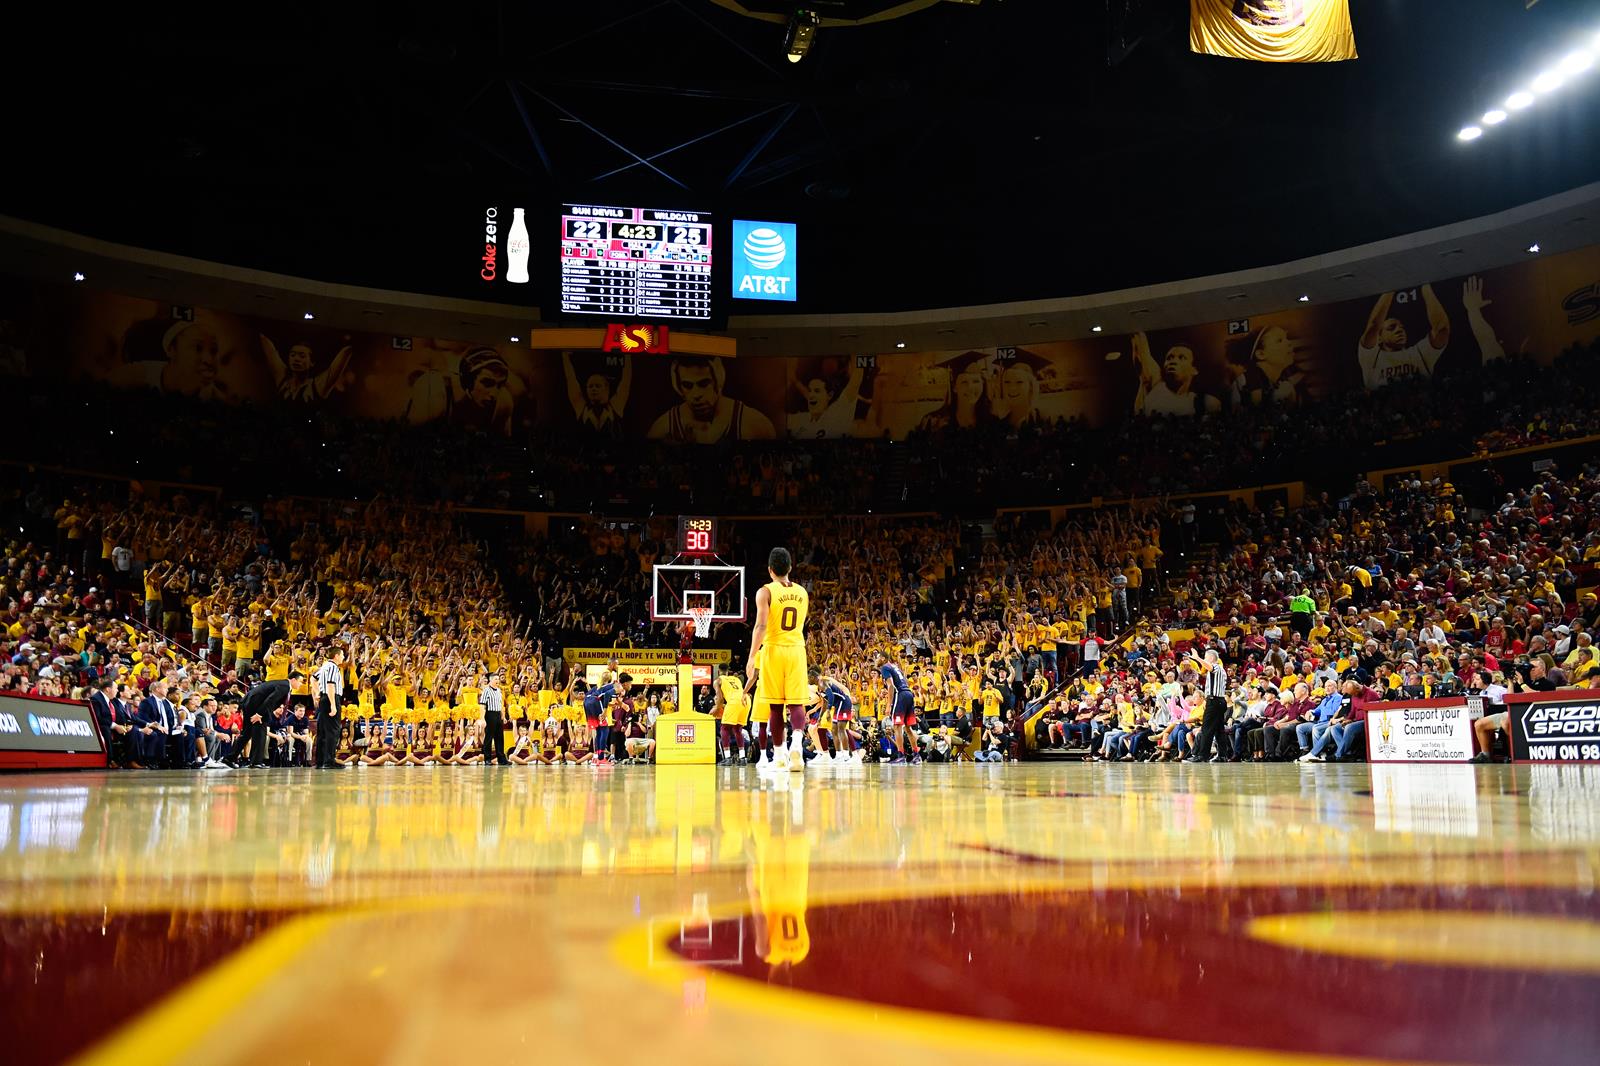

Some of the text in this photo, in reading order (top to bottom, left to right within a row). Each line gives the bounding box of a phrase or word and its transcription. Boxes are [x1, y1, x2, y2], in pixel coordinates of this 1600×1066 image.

[572, 207, 624, 217] SUN DEVILS
[654, 212, 699, 222] WILDCATS
[573, 221, 601, 238] 22
[618, 225, 656, 239] 4:23
[674, 227, 701, 245] 25
[480, 207, 497, 281] Coke zero
[739, 274, 791, 294] AT&T
[1396, 289, 1417, 304] Q1
[172, 307, 193, 320] L1
[1229, 320, 1249, 334] P1
[393, 337, 411, 349] L2
[602, 323, 670, 354] ASU
[999, 349, 1017, 360] N2
[858, 357, 875, 368] N1
[689, 520, 712, 531] 4:23
[687, 531, 709, 550] 30
[778, 593, 804, 604] HOLDER
[781, 606, 798, 632] 0
[578, 651, 611, 659] ABANDON
[612, 651, 625, 660] ALL
[625, 652, 643, 660] HOPE
[645, 652, 655, 660] YE
[656, 652, 673, 660] WHO
[699, 652, 718, 660] HERE
[1403, 708, 1461, 722] Support your
[1529, 705, 1600, 722] ARIZO
[37, 716, 94, 737] KONICA MINOLTA
[1404, 722, 1454, 737] Community
[1406, 749, 1465, 759] SunDevilClub.com
[1528, 745, 1557, 760] NOW
[1559, 745, 1579, 760] ON
